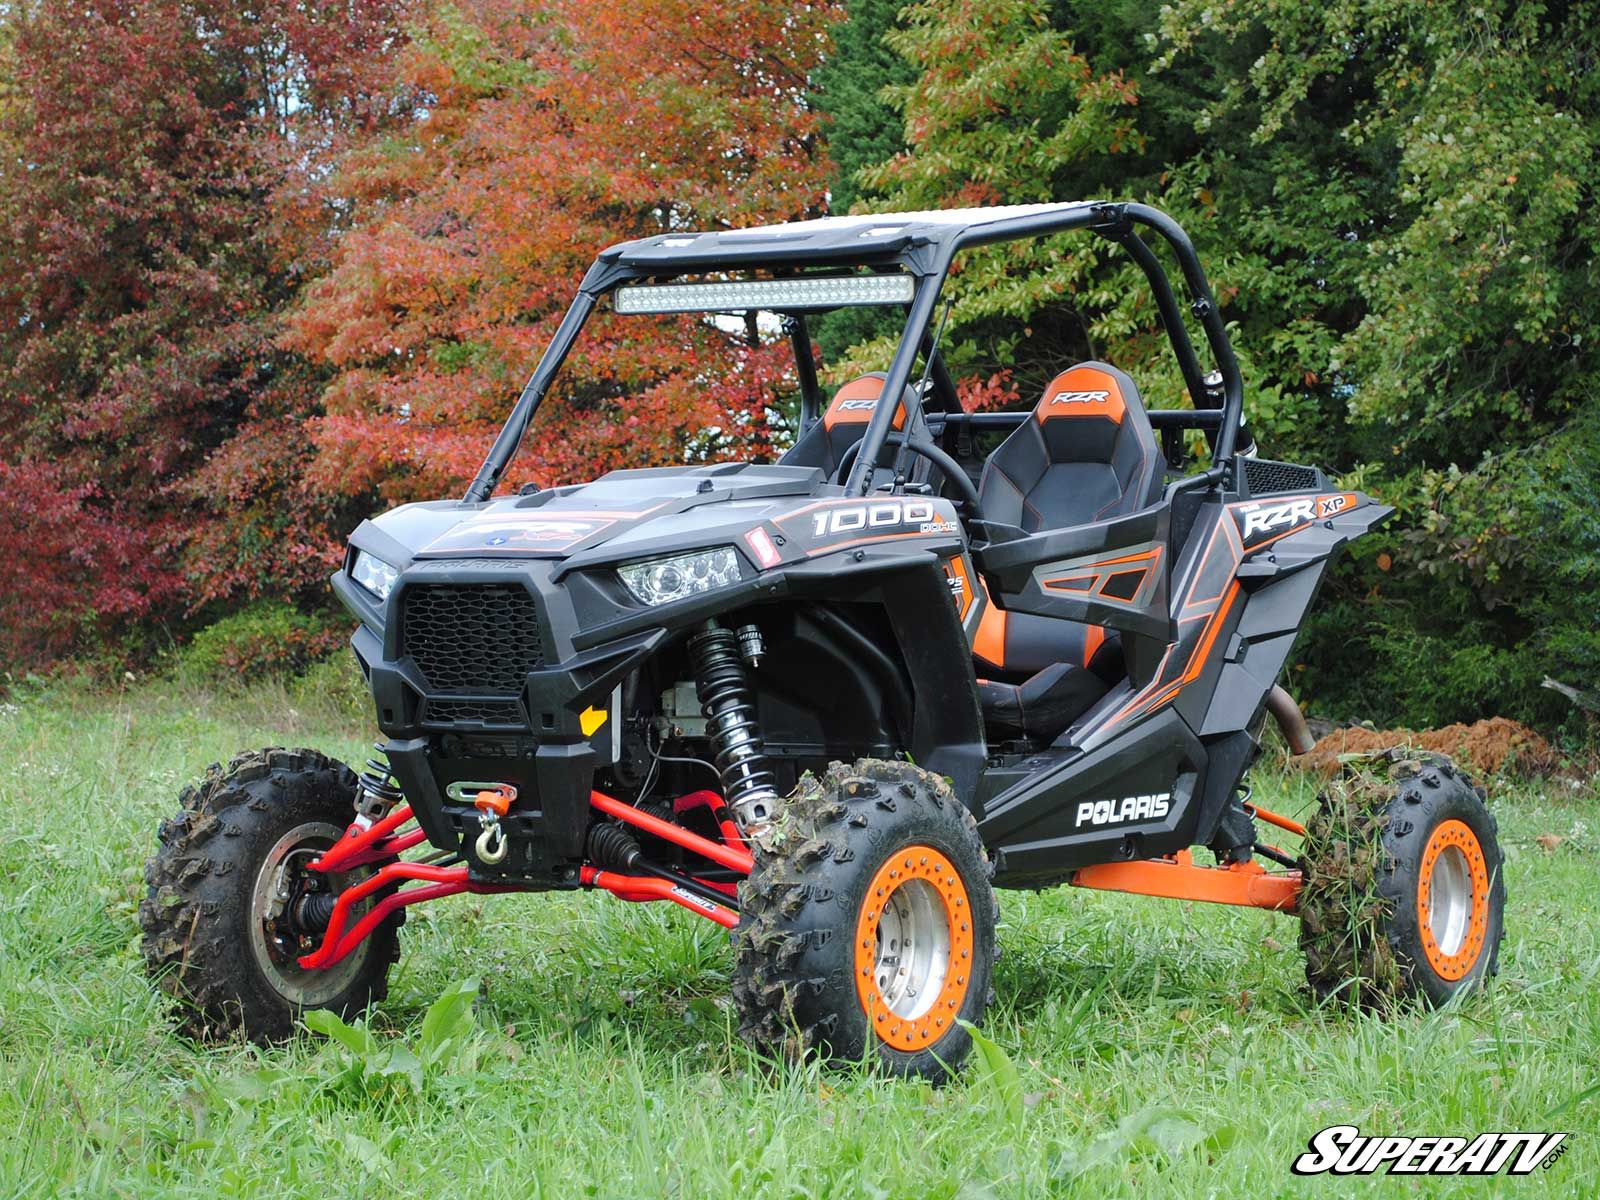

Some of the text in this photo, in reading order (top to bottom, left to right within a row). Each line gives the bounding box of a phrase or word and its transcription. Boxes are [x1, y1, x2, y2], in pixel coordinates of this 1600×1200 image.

[1051, 390, 1110, 405] RZR
[812, 502, 934, 538] 1000
[920, 521, 958, 533] DOHC
[1243, 497, 1345, 540] RZR XP
[946, 575, 964, 588] PS
[1075, 793, 1171, 828] POLARIS
